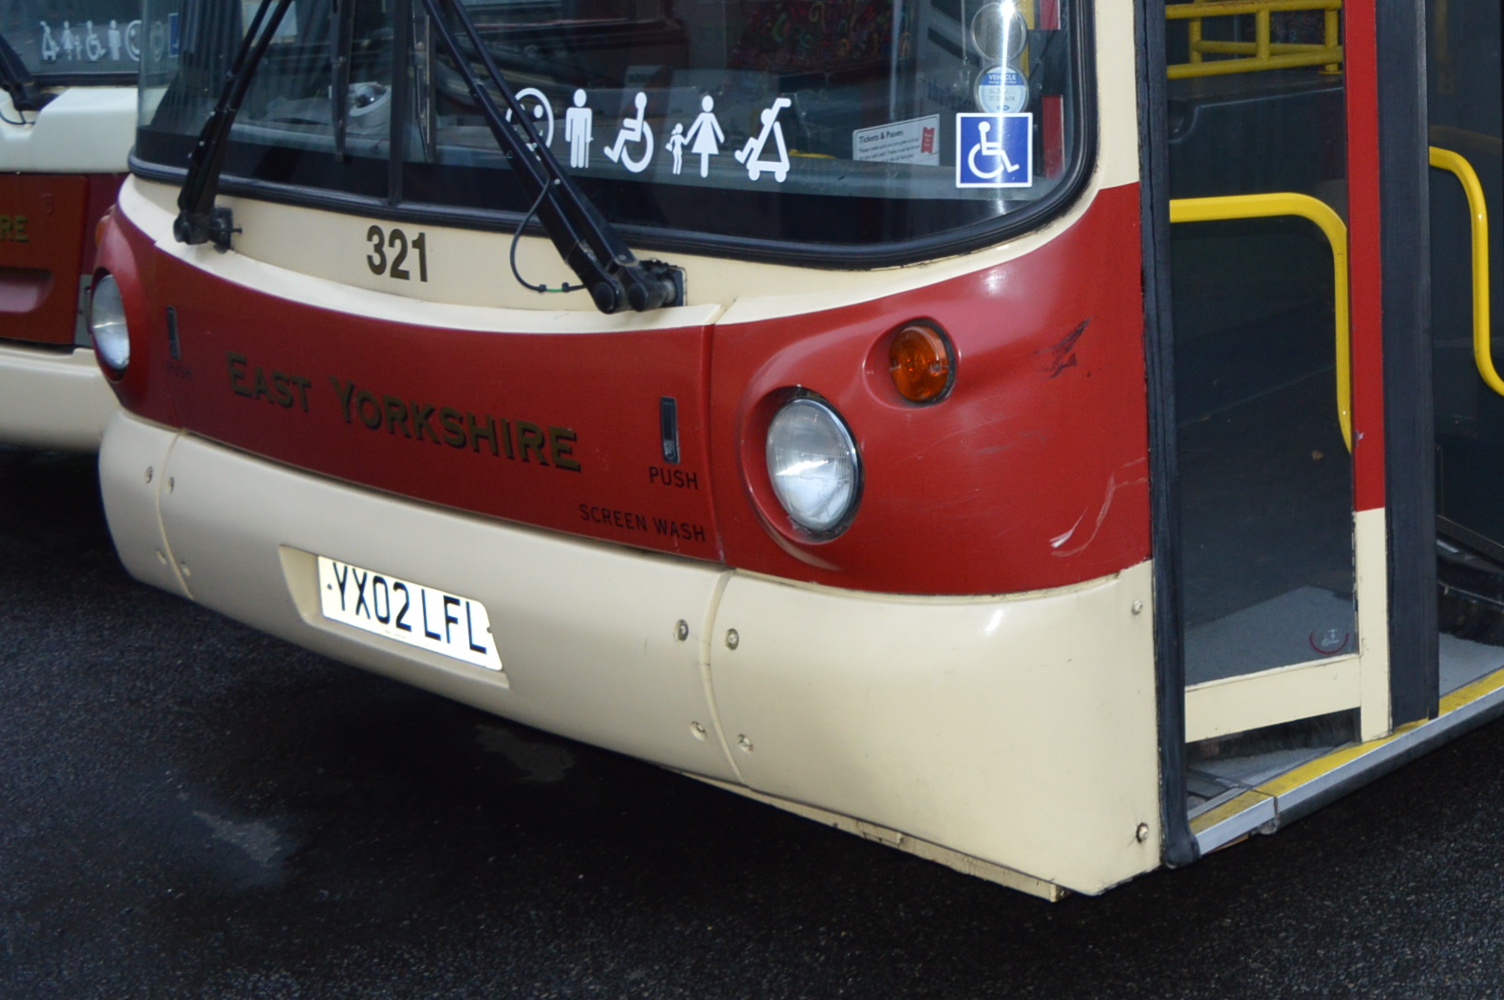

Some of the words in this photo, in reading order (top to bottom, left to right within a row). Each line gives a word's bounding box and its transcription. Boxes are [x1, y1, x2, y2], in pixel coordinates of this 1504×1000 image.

[858, 133, 880, 144] Tickets
[366, 224, 428, 283] 321
[225, 351, 312, 412] EAST
[330, 374, 582, 473] YORKSHIRE
[649, 466, 698, 490] PUSH
[579, 503, 648, 532] SCREEN
[653, 516, 706, 543] WASH
[332, 561, 412, 633] YX02
[421, 588, 488, 655] LFL
